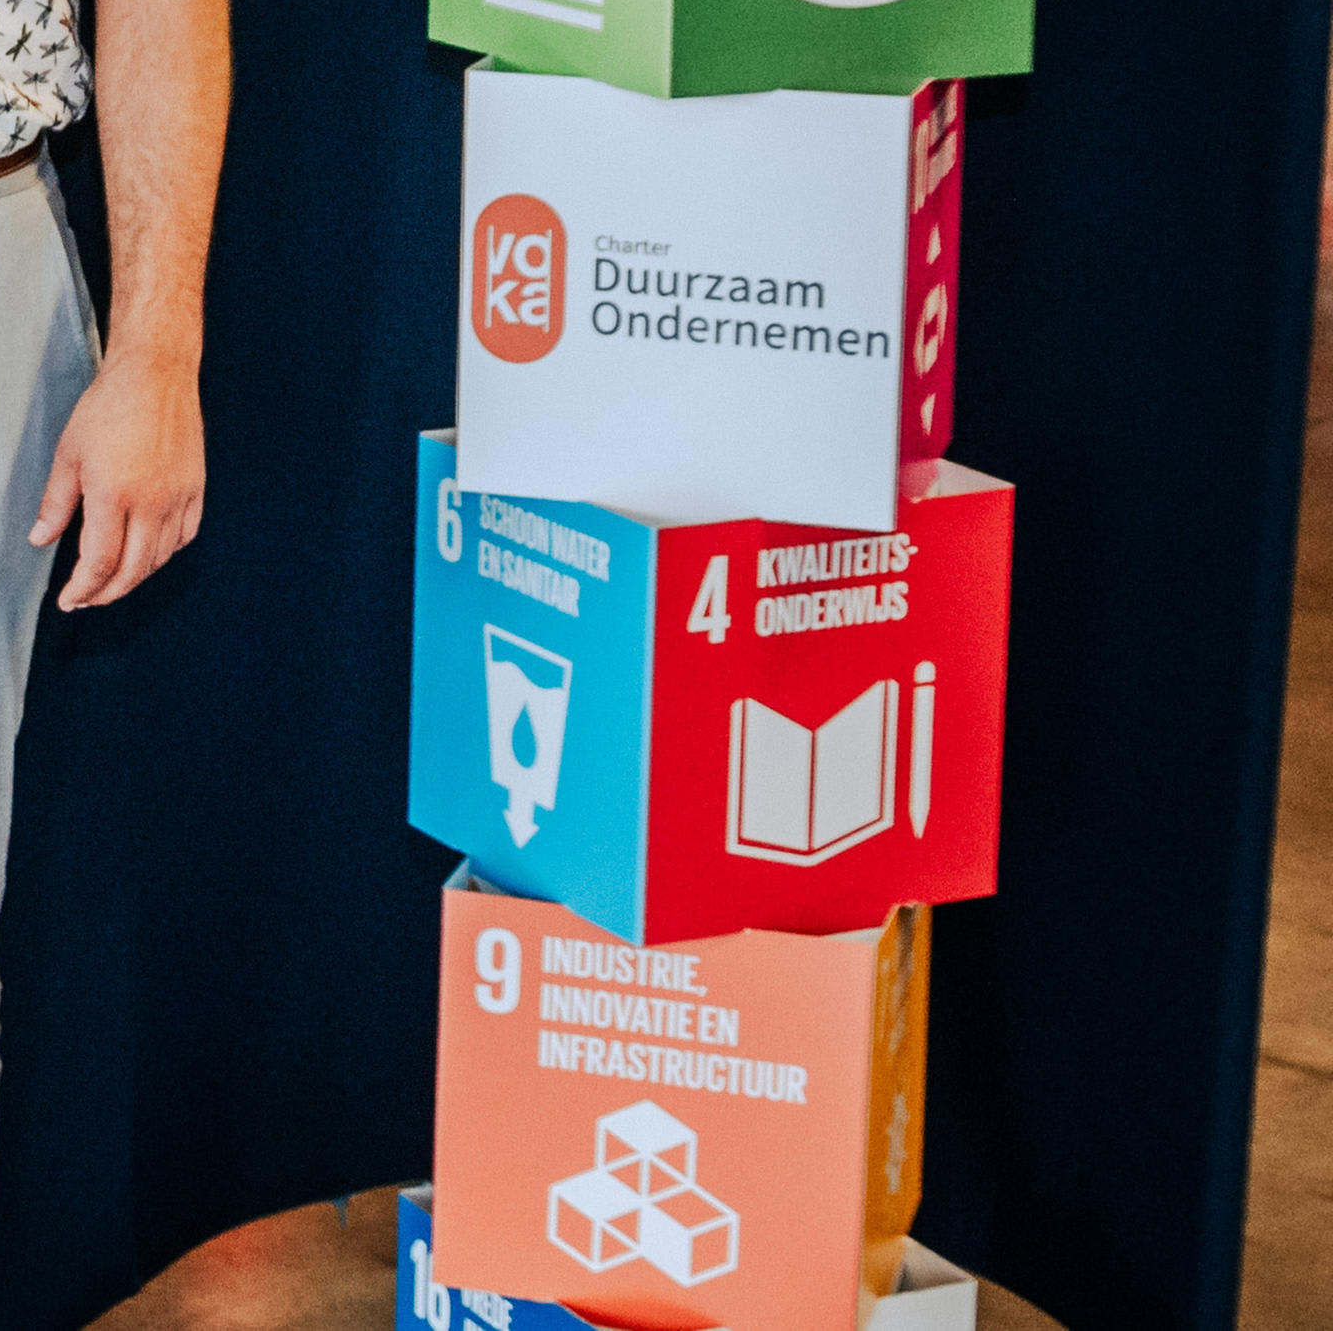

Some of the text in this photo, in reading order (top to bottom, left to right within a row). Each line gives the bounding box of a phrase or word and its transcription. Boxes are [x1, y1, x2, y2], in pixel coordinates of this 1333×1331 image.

[594, 234, 672, 257] Charter
[593, 258, 825, 309] Duurzaam
[591, 301, 890, 359] Ondernemen
[437, 477, 463, 563] 6
[480, 494, 611, 583] SCHOON WATER
[478, 539, 502, 582] EN
[756, 532, 919, 589] KWALITEITS-
[686, 554, 732, 645] 4
[755, 581, 909, 637] ONDERWIJS
[474, 927, 523, 1015] 9
[541, 935, 708, 998] INDUSTRIE,
[539, 982, 740, 1047] INNOVATIE EN
[537, 1029, 808, 1106] INFRASTRUCTUUR
